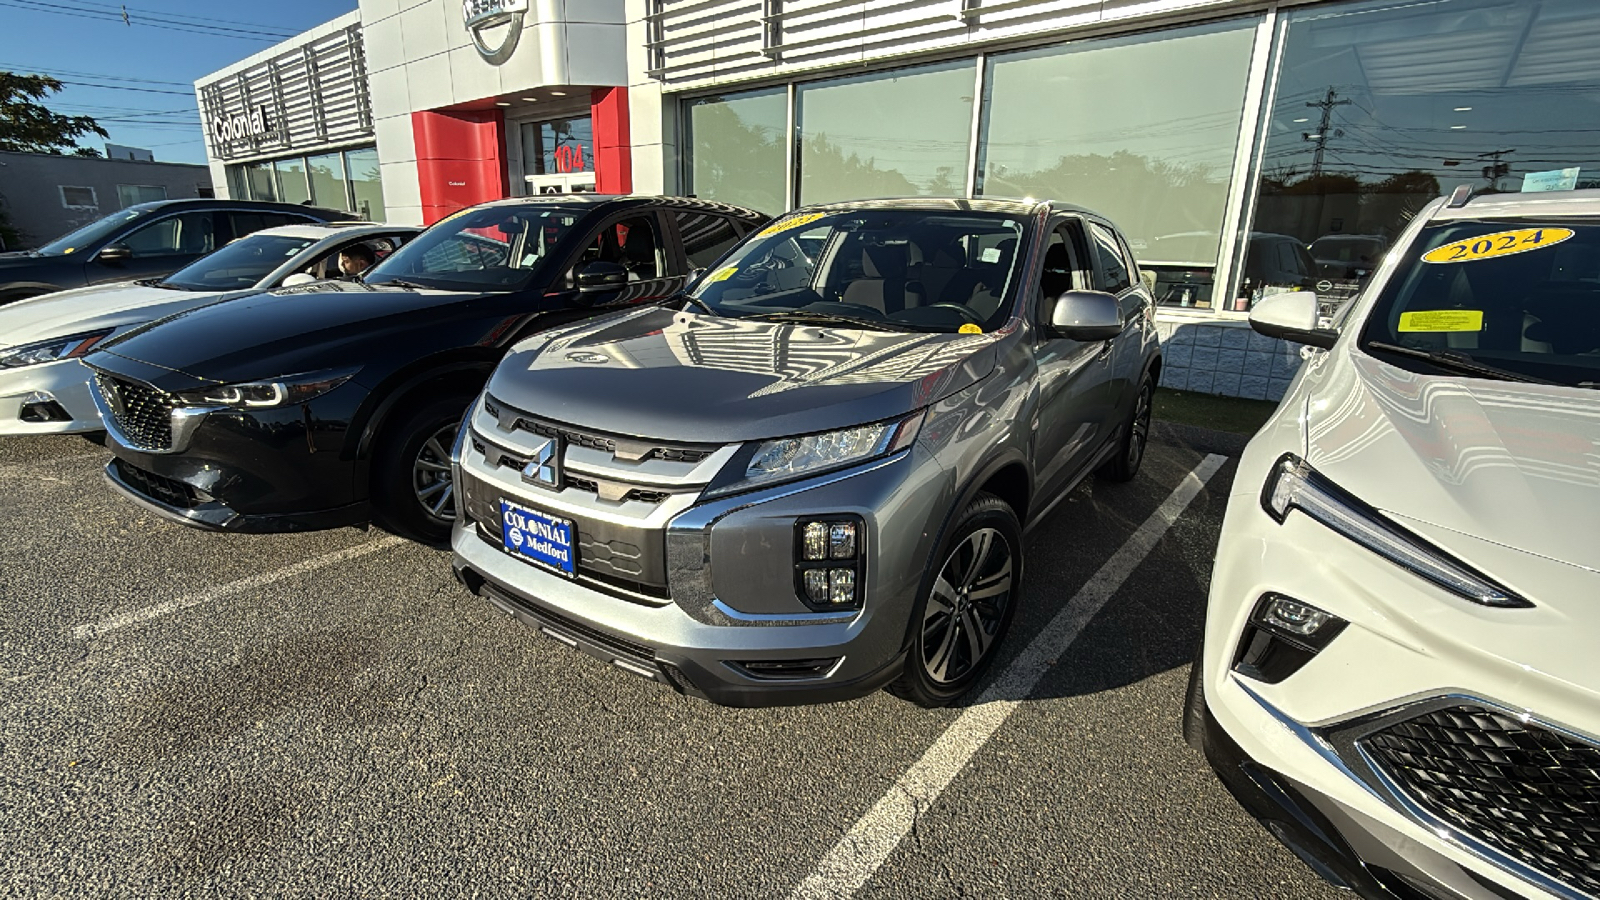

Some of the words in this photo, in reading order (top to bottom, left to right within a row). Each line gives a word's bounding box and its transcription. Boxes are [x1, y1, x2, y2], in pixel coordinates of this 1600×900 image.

[214, 104, 265, 143] Colonial
[554, 144, 585, 173] 104
[1448, 229, 1545, 261] 2024
[504, 510, 570, 547] COLONIAL
[526, 534, 569, 562] Medford
